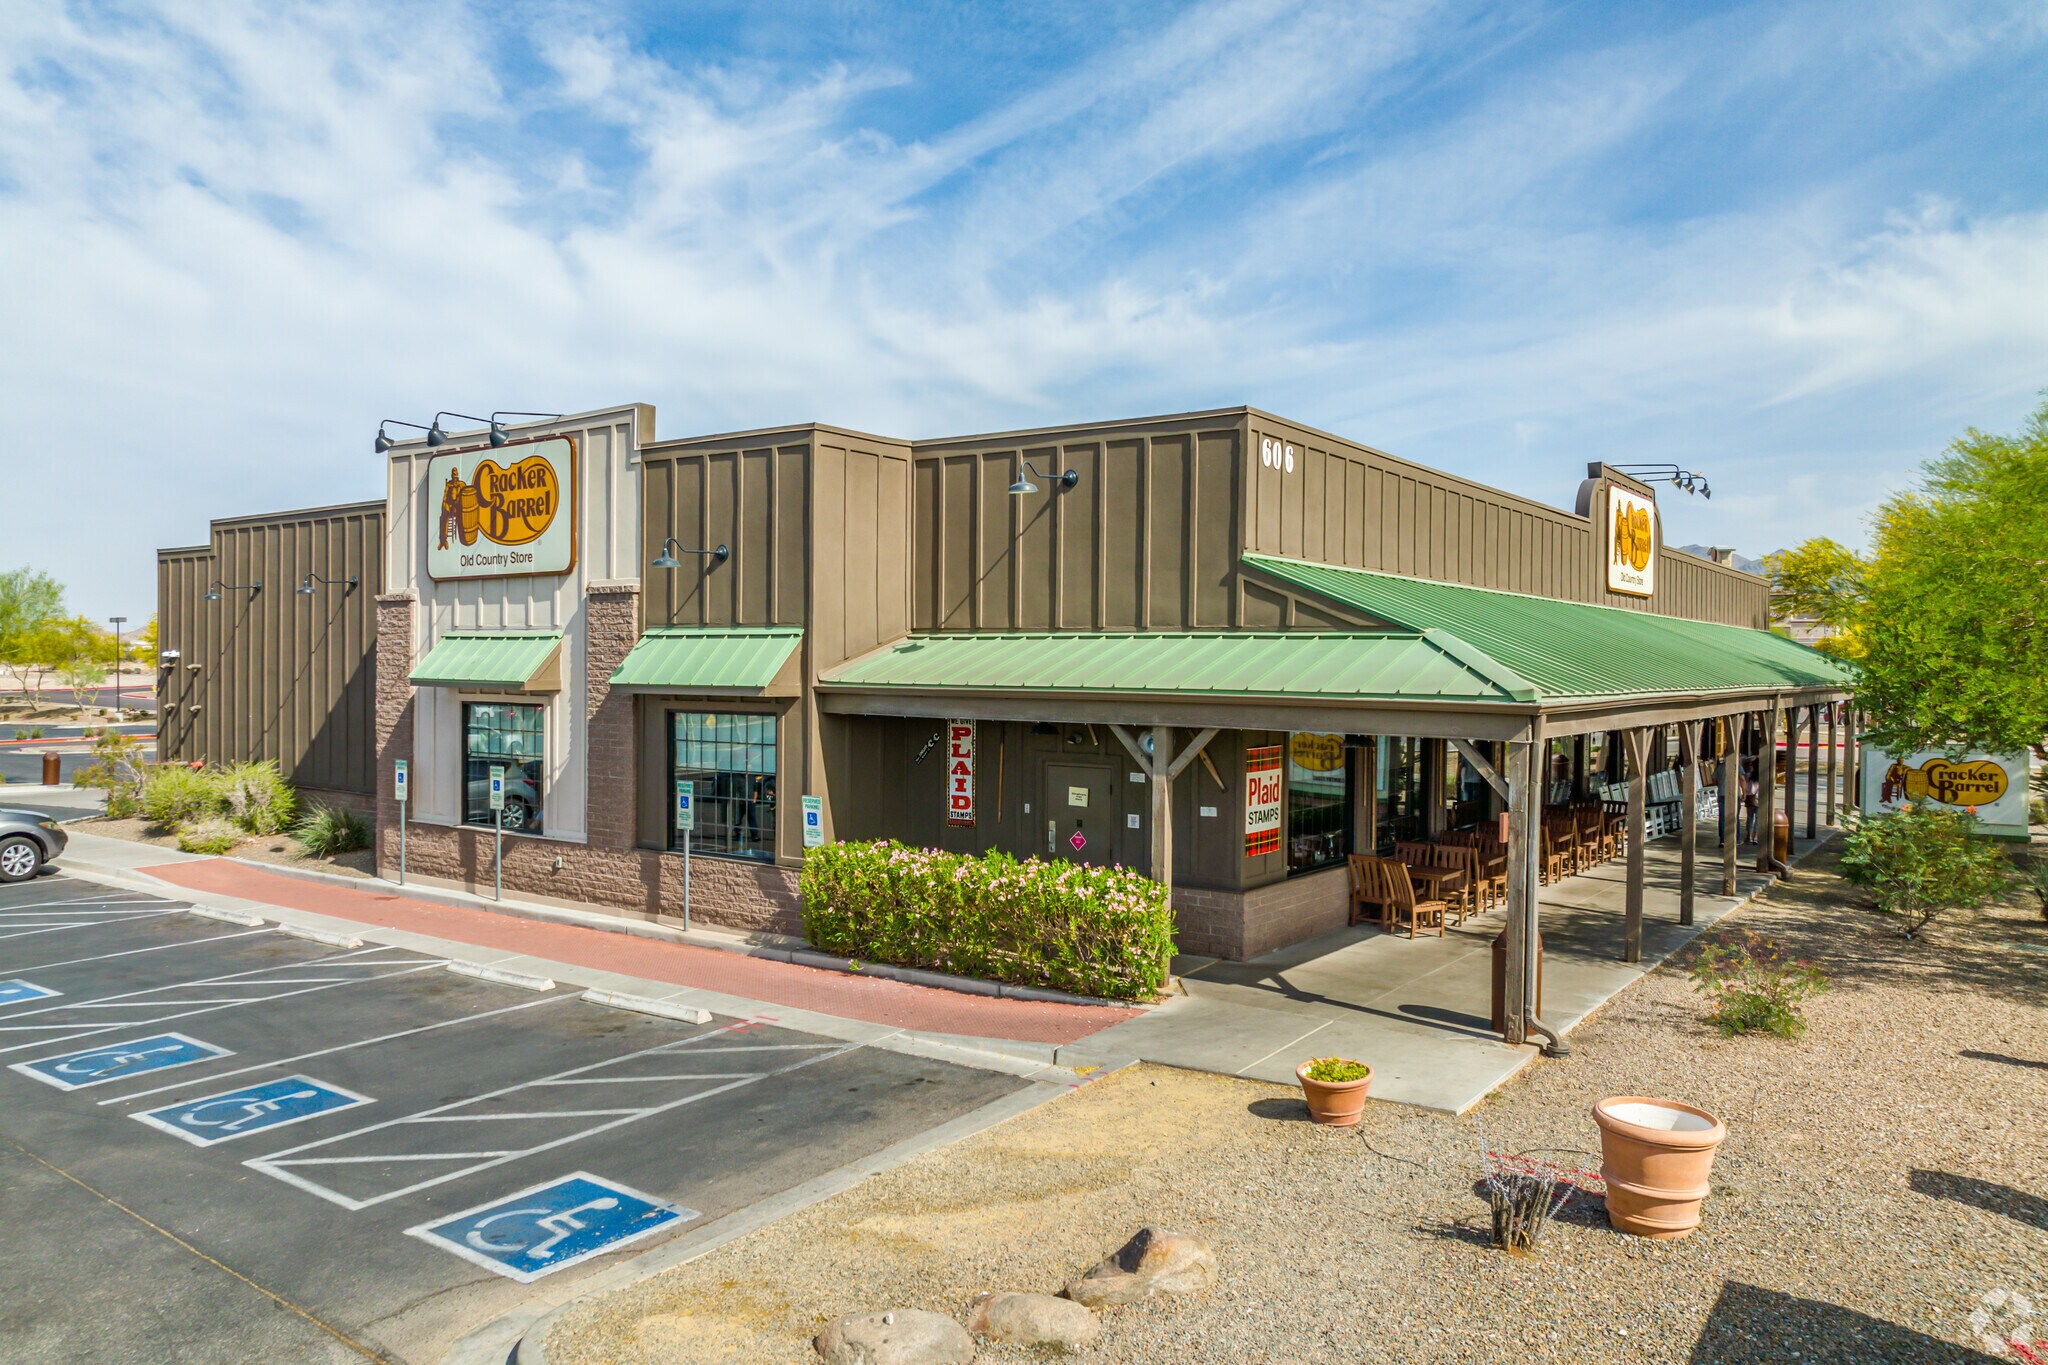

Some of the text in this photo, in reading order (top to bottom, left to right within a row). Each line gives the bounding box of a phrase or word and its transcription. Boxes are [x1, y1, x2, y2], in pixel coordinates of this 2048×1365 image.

[1262, 438, 1294, 473] 606
[474, 464, 547, 508] Cracker
[490, 490, 550, 540] Barrel
[460, 551, 533, 567] Old Country Store
[950, 727, 972, 810] PLAID
[1927, 763, 1999, 789] Cracker
[1248, 774, 1280, 807] Plaid
[1938, 780, 1999, 803] Barrel
[950, 811, 972, 819] STAMPS
[1248, 807, 1279, 826] STAMPS
